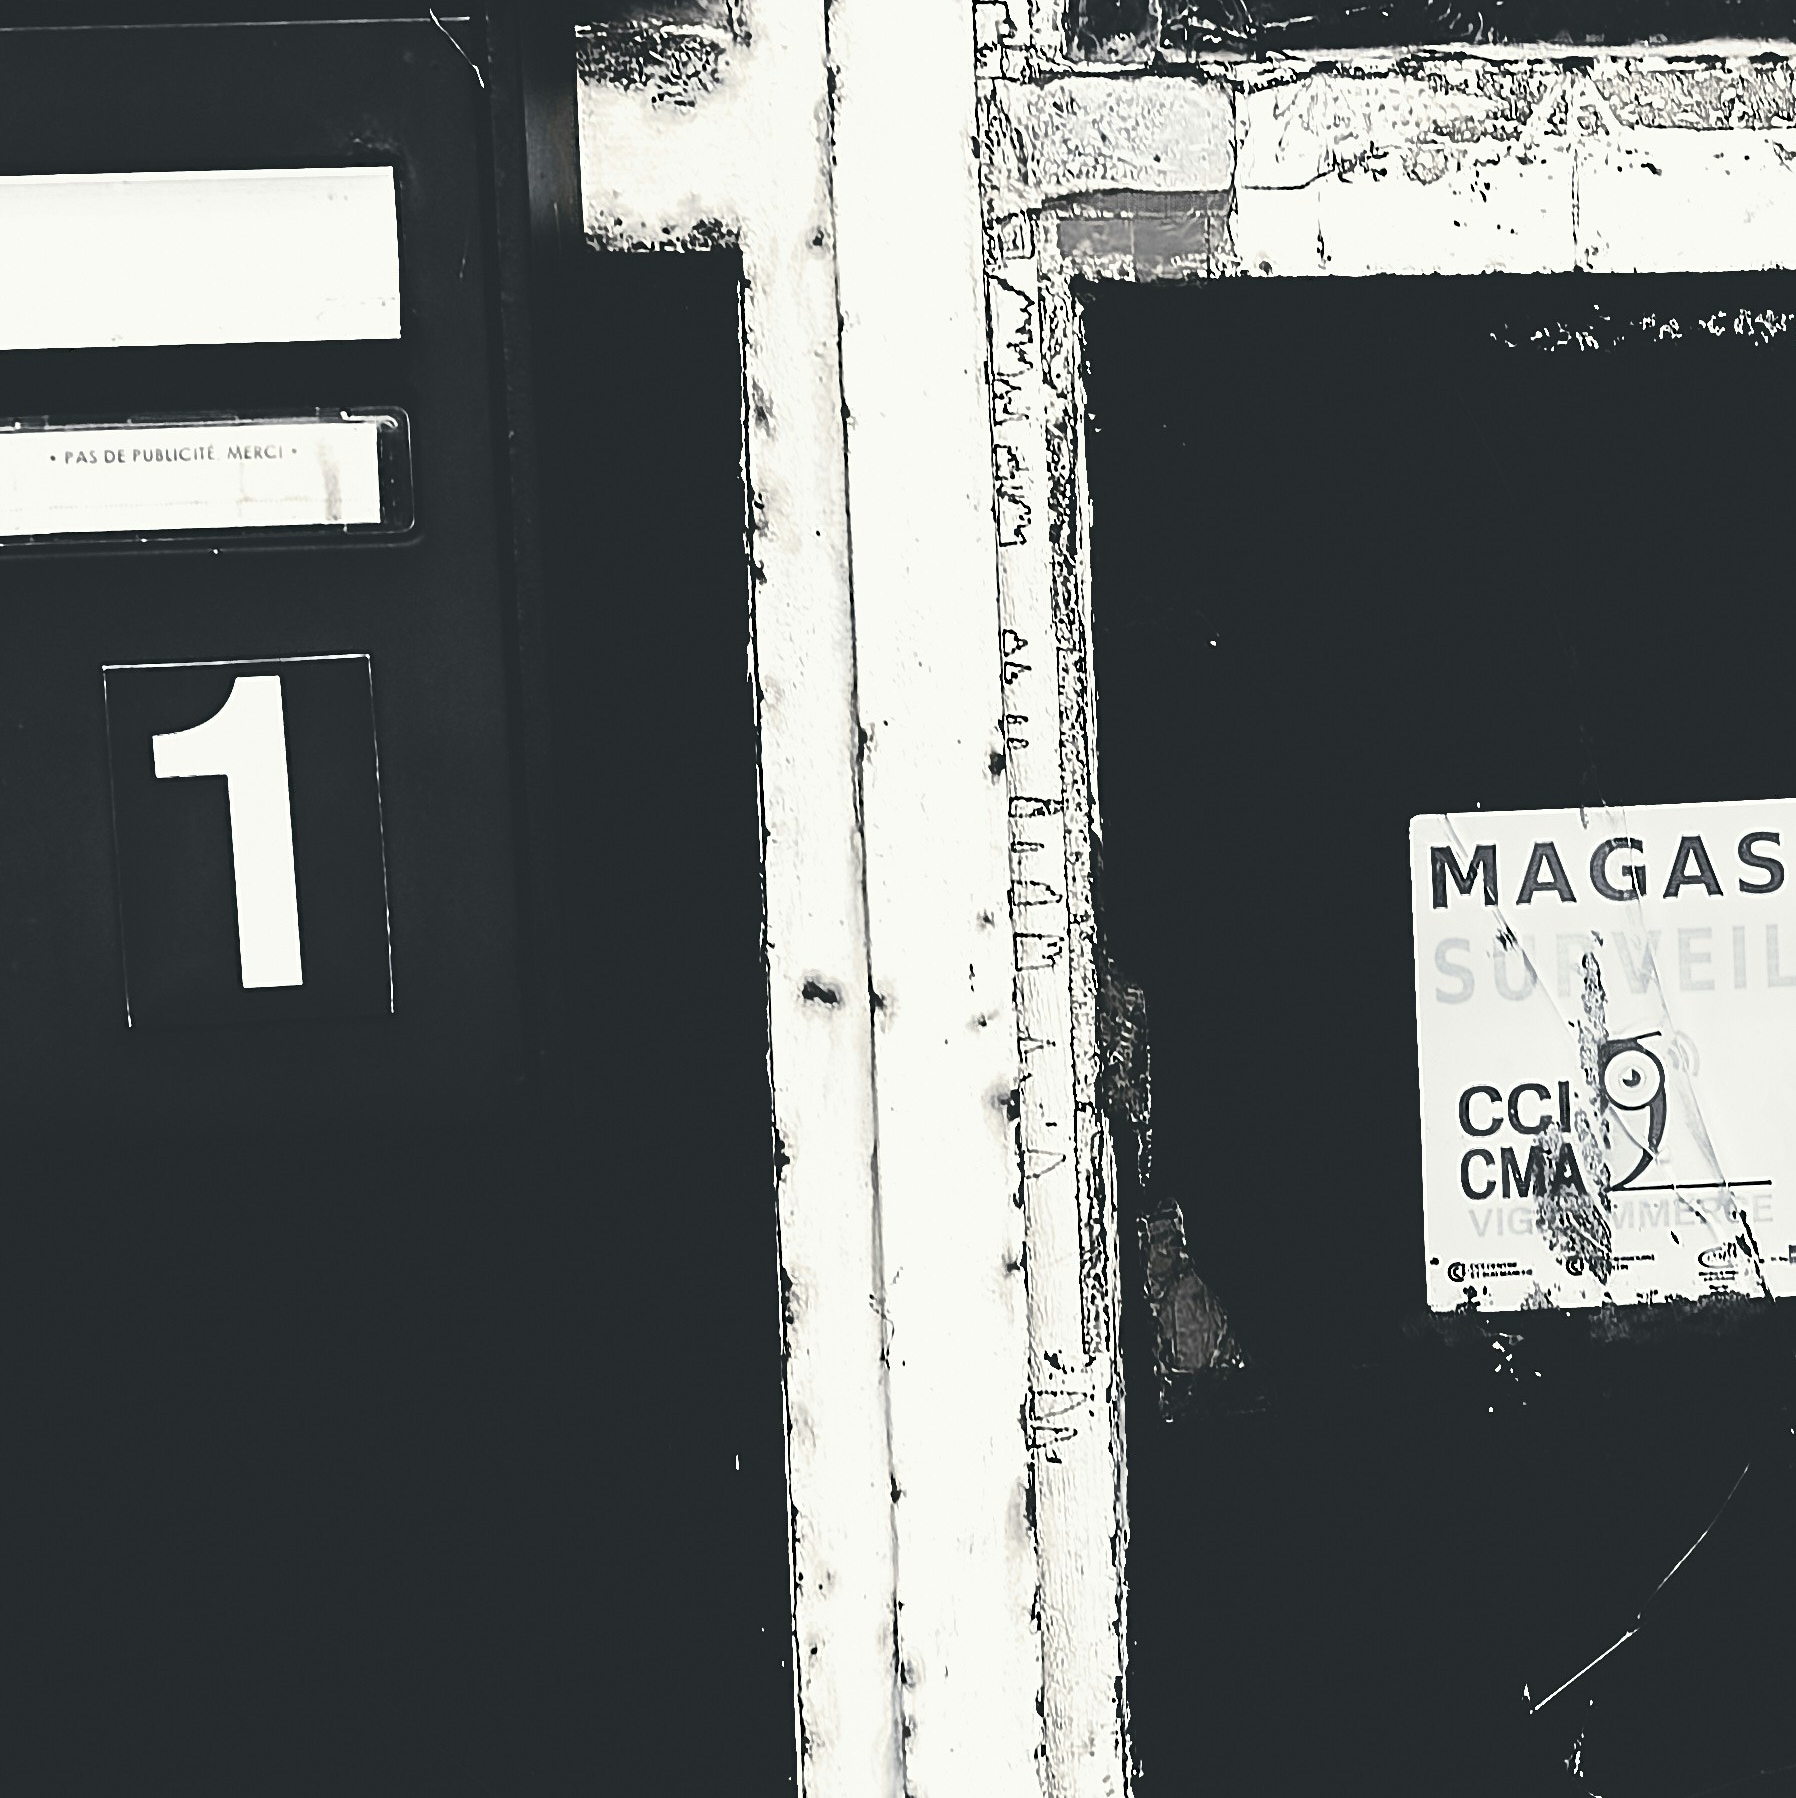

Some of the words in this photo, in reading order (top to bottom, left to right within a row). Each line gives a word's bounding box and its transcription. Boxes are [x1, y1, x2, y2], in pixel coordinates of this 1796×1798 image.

[64, 450, 98, 464] PAS
[103, 449, 126, 464] DE
[227, 444, 283, 460] MERCI
[152, 675, 304, 990] 1
[1458, 1080, 1572, 1137] CCI
[1460, 1142, 1588, 1201] CMA
[1468, 1192, 1774, 1238] VIGMMERCE
